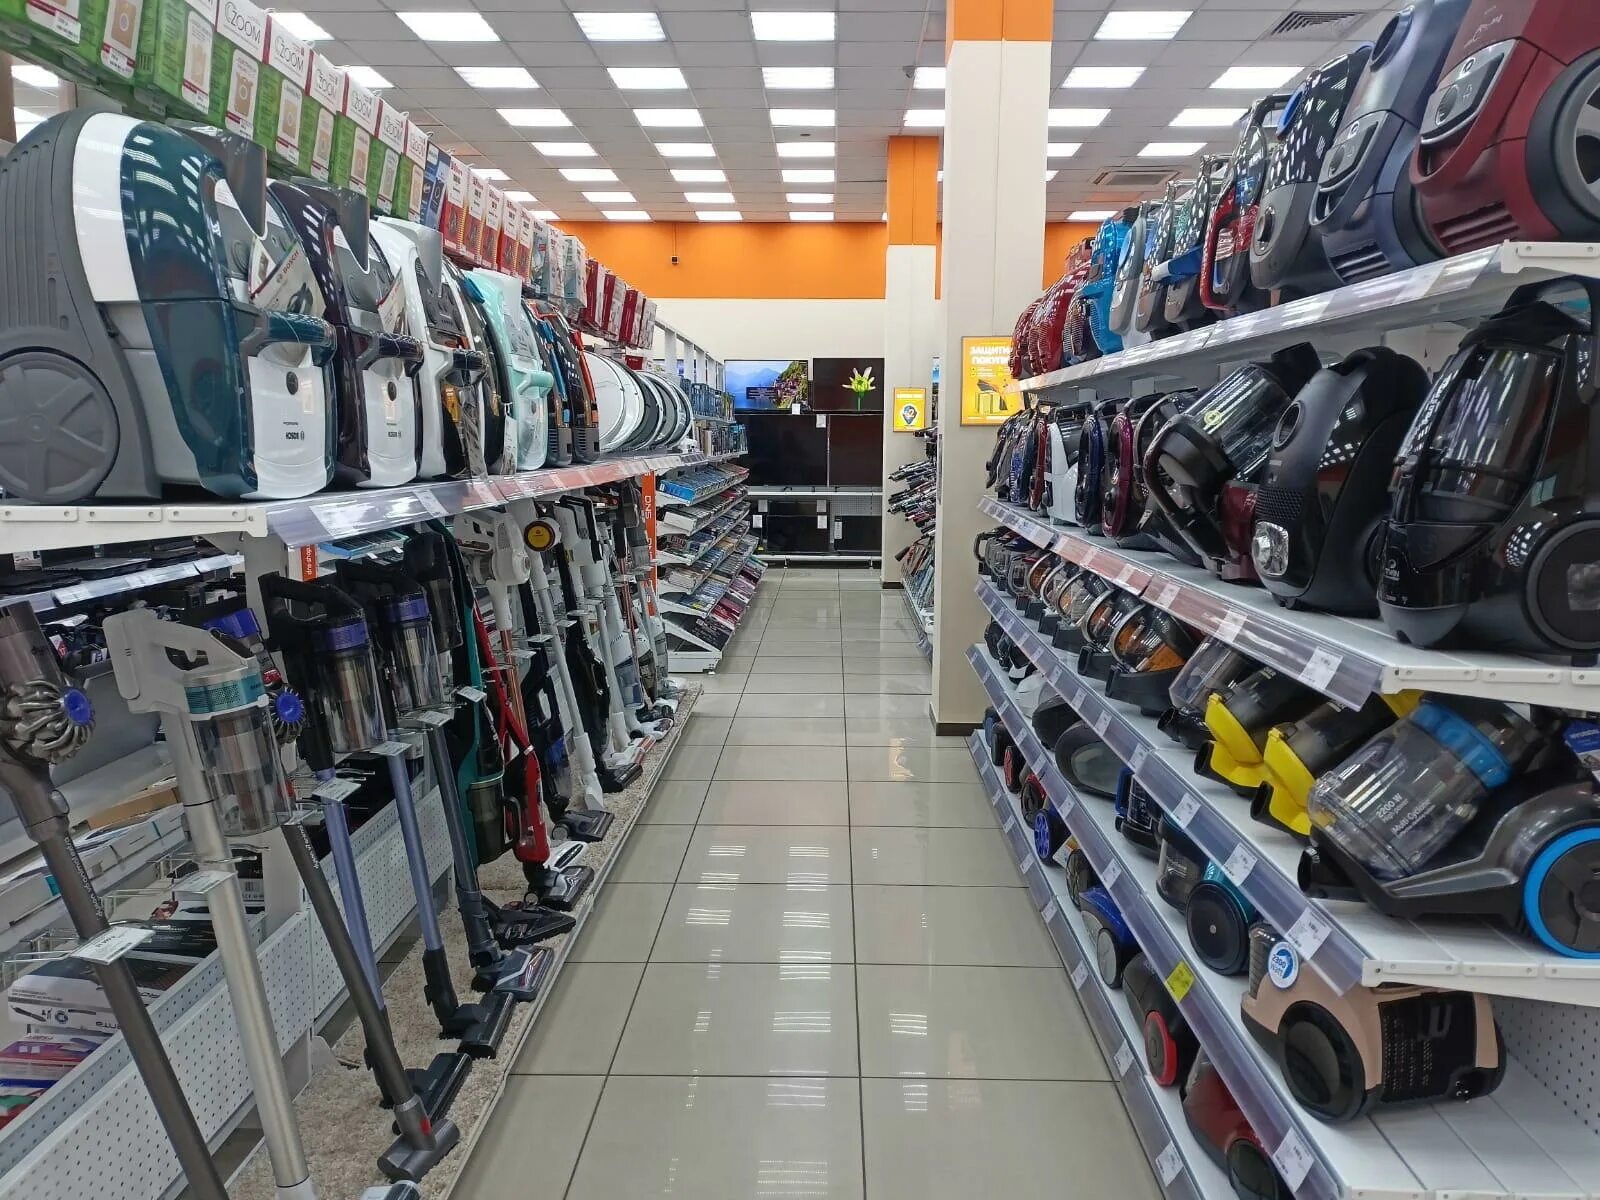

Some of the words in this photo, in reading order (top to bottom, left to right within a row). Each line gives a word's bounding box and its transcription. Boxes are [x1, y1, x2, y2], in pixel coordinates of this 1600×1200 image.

[283, 250, 299, 275] BOSCH
[644, 495, 653, 520] DNS
[1376, 800, 1396, 818] 2200
[1392, 792, 1403, 803] W
[1271, 953, 1287, 969] 2300
